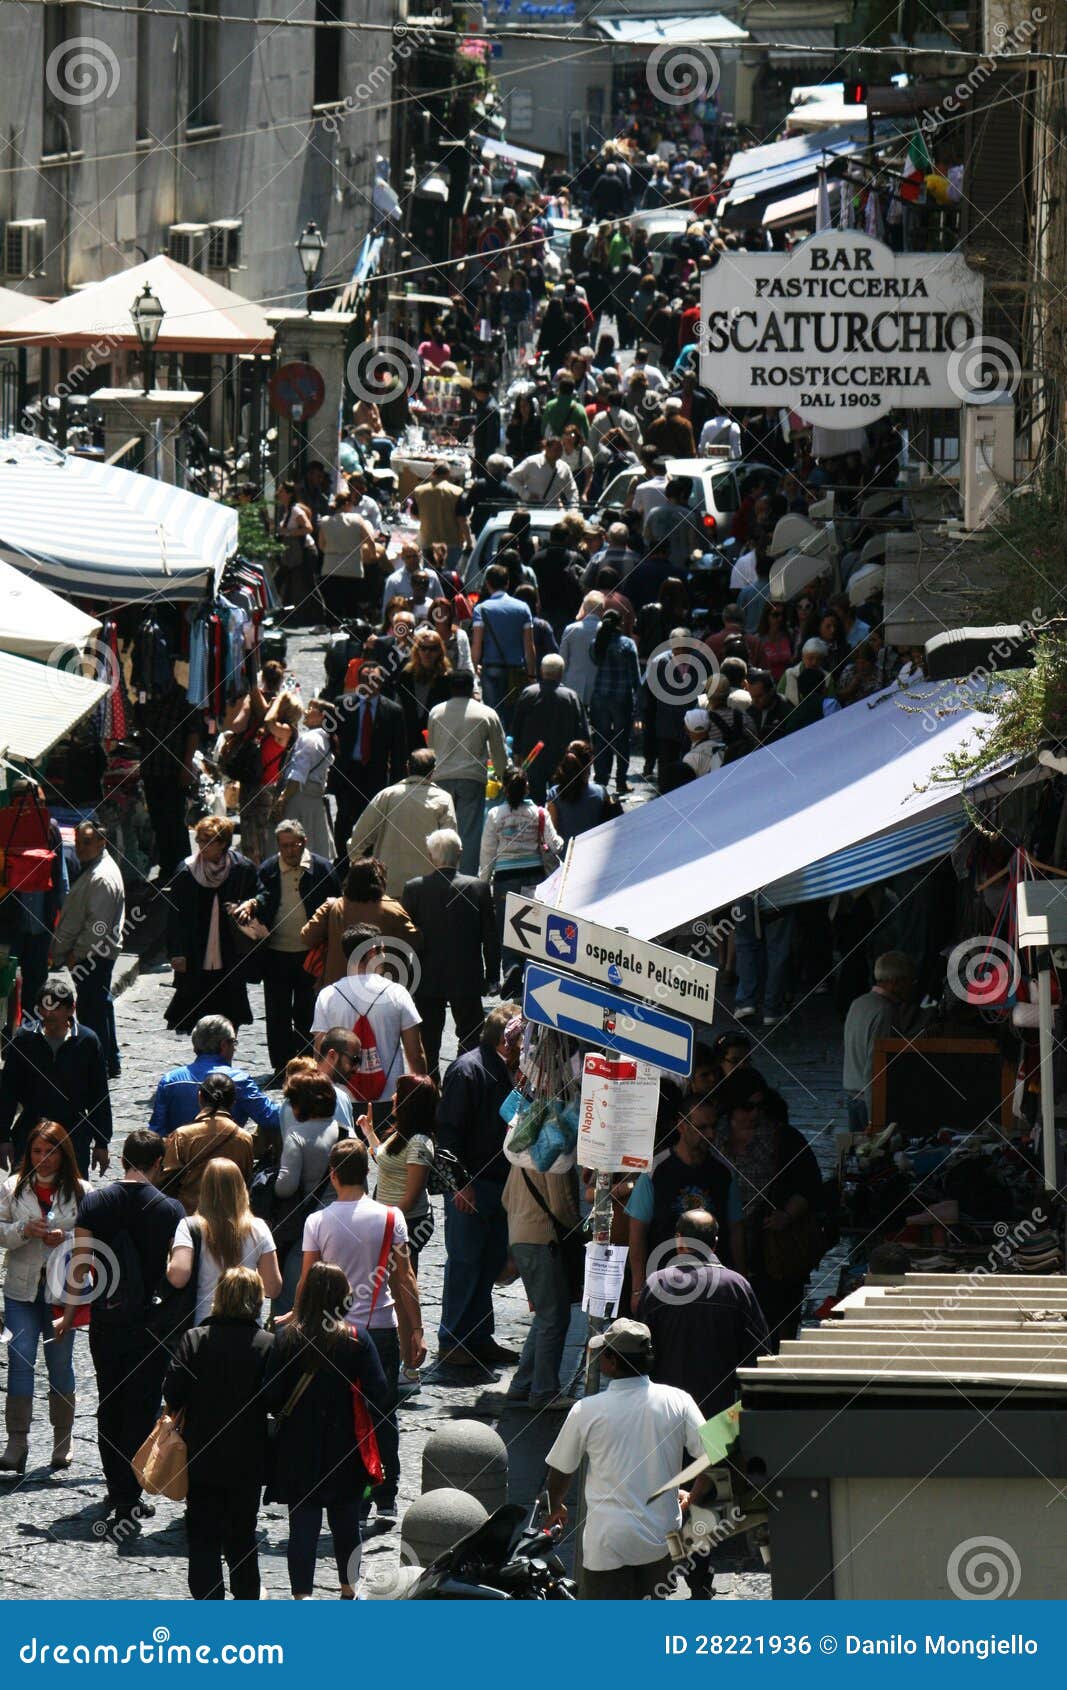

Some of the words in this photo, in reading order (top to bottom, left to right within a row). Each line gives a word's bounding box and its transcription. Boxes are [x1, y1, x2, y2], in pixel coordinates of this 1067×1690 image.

[810, 248, 875, 271] BAR
[755, 278, 929, 298] PASTICCERIA
[707, 311, 975, 353] SCATURCHIO
[750, 367, 931, 387] ROSTICCERIA
[800, 394, 834, 407] DAL
[839, 394, 881, 407] 1903
[585, 942, 642, 974] ospedale
[647, 960, 709, 1002] Pellegrini
